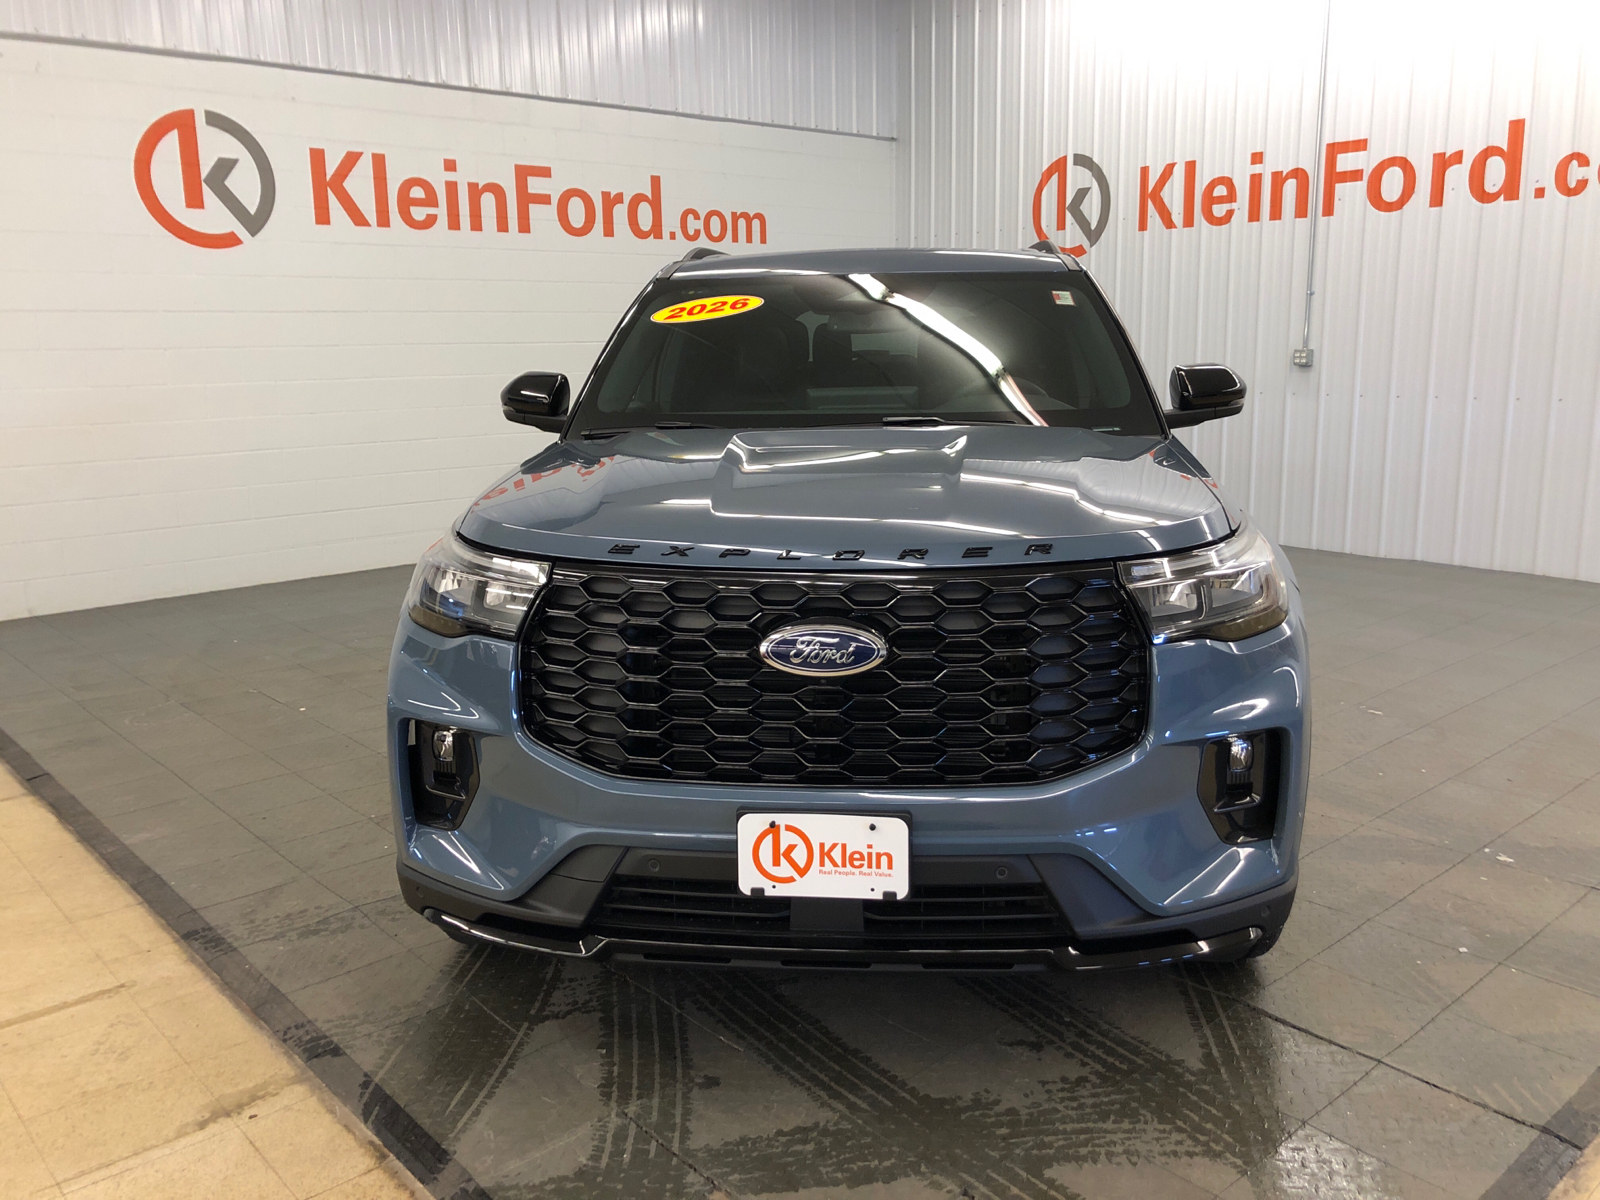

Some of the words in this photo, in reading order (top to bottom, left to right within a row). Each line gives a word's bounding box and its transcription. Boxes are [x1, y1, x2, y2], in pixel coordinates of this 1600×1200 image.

[1137, 118, 1600, 232] KleinFord.c
[308, 147, 768, 245] KleinFord.com
[663, 298, 751, 321] 2026
[607, 542, 1054, 561] EXPLORER
[788, 635, 857, 665] Ford
[818, 842, 894, 870] Klein
[834, 869, 857, 877] People.
[874, 870, 894, 878] Value.
